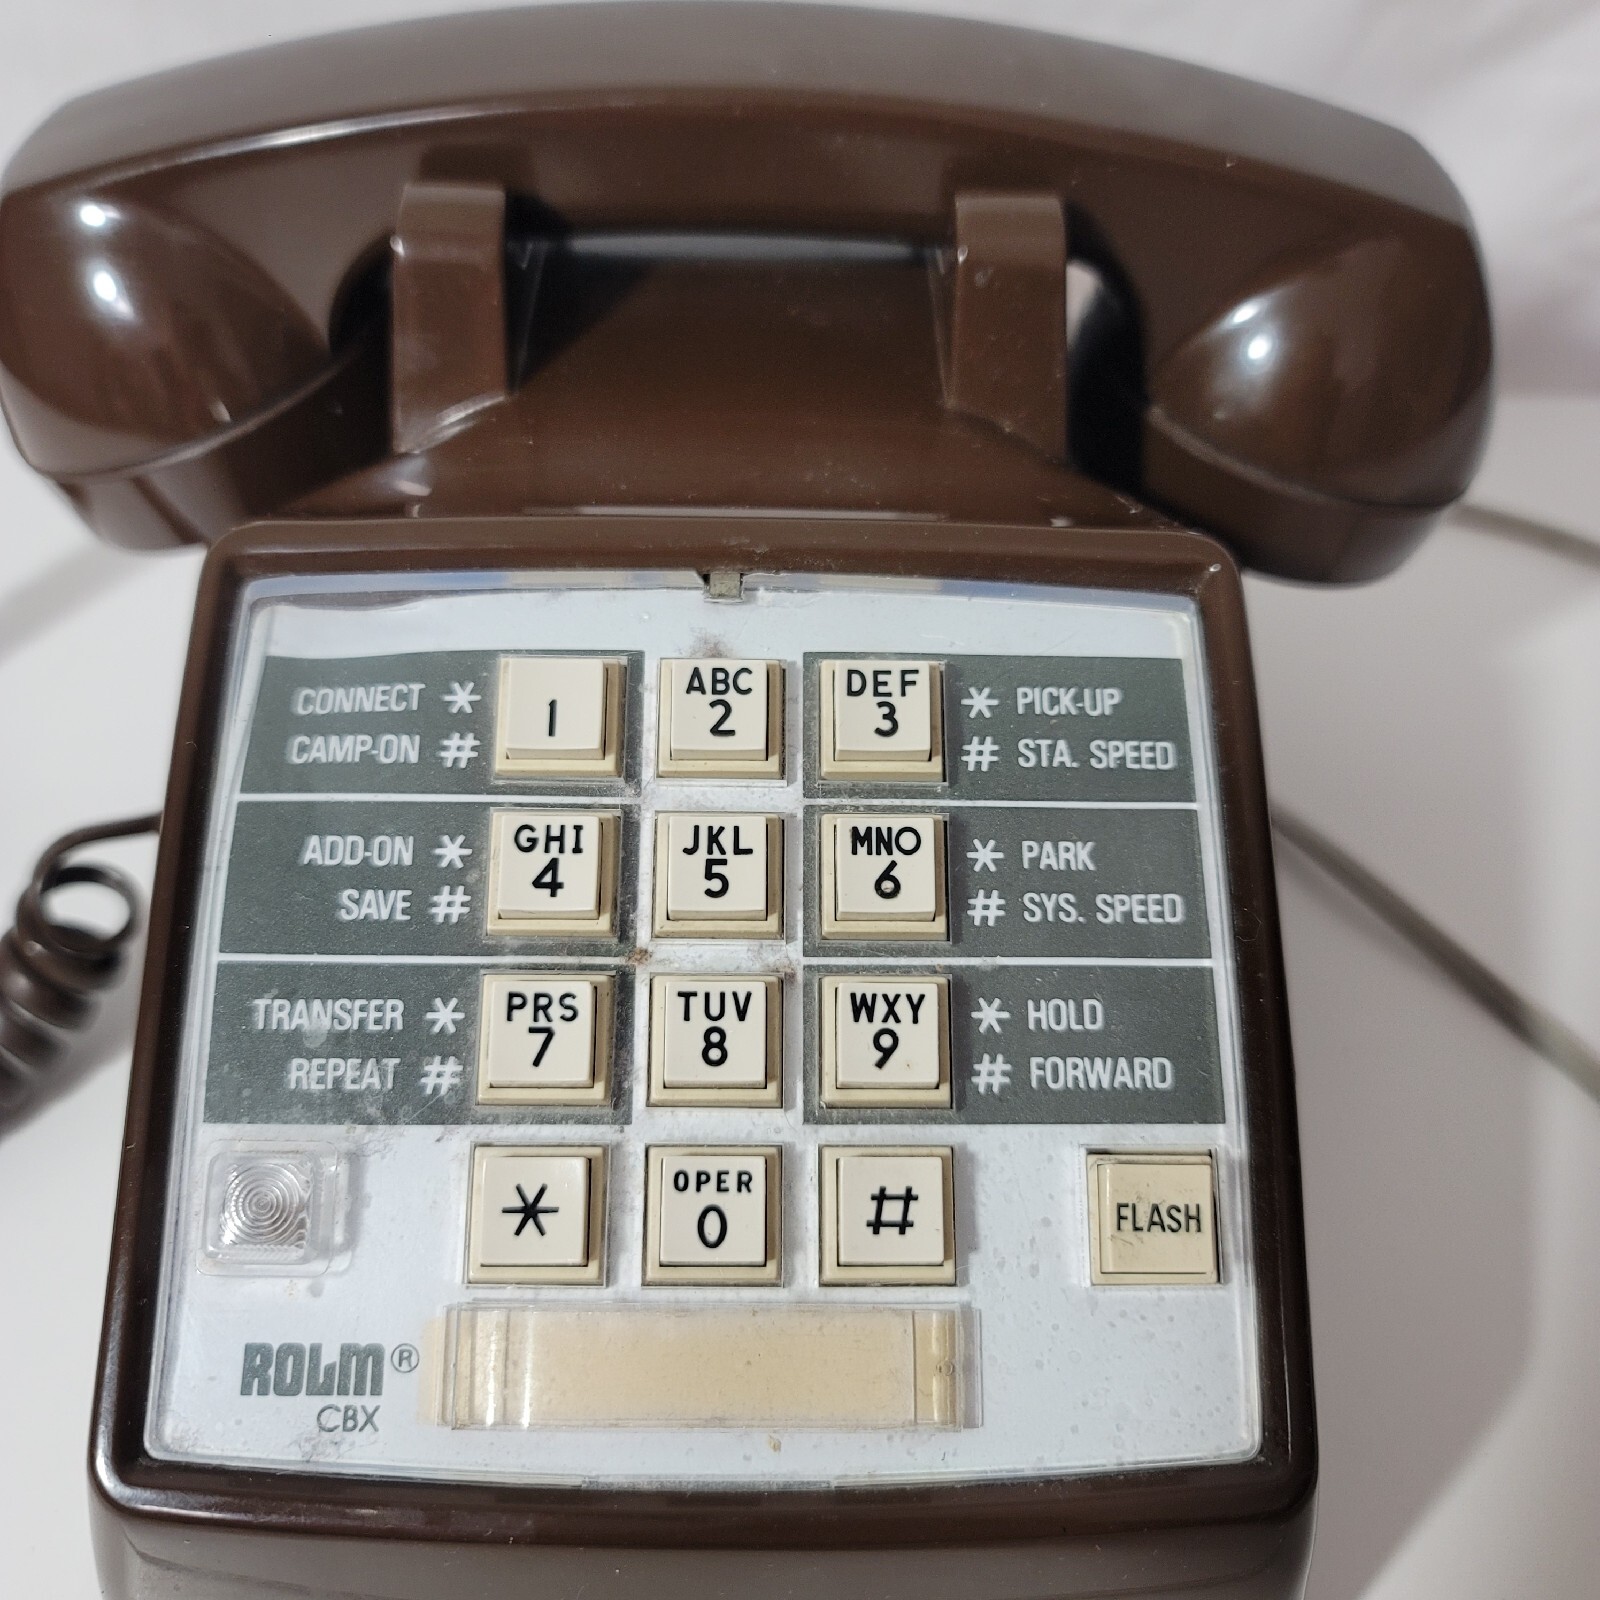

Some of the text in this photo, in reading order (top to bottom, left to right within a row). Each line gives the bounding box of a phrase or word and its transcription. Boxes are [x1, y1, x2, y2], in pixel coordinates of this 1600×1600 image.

[686, 667, 752, 695] ABC
[847, 669, 919, 697] DEF
[295, 683, 425, 715] CONNECT
[1017, 687, 1121, 716] PICK-UP
[547, 699, 558, 737] 1
[709, 699, 735, 737] 2
[875, 701, 898, 737] 3
[290, 734, 420, 763] CAMP-ON
[1018, 739, 1078, 767] STA.
[1090, 740, 1176, 769] SPEED
[303, 835, 413, 866] ADD-ON
[514, 824, 583, 854] GHI
[683, 825, 753, 855] JKL
[851, 826, 921, 855] MNO
[1022, 841, 1095, 870] PARK
[532, 858, 563, 897] 4
[705, 859, 729, 898] 5
[874, 860, 901, 899] 6
[339, 889, 411, 920] SAVE
[1023, 893, 1084, 922] SYS.
[1097, 894, 1184, 923] SPEED
[254, 998, 403, 1031] TRANSFER
[507, 992, 578, 1022] PRS
[677, 991, 751, 1021] TUV
[850, 993, 925, 1024] WXY
[1028, 999, 1103, 1031] HOLD
[528, 1027, 554, 1067] 7
[702, 1026, 728, 1067] 8
[873, 1028, 899, 1069] 9
[288, 1058, 400, 1090] REPEAT
[1030, 1057, 1172, 1089] FORWARD
[674, 1170, 752, 1193] OPER
[697, 1205, 727, 1249] 0
[1117, 1203, 1201, 1233] FLASH
[317, 1405, 379, 1433] CBX
